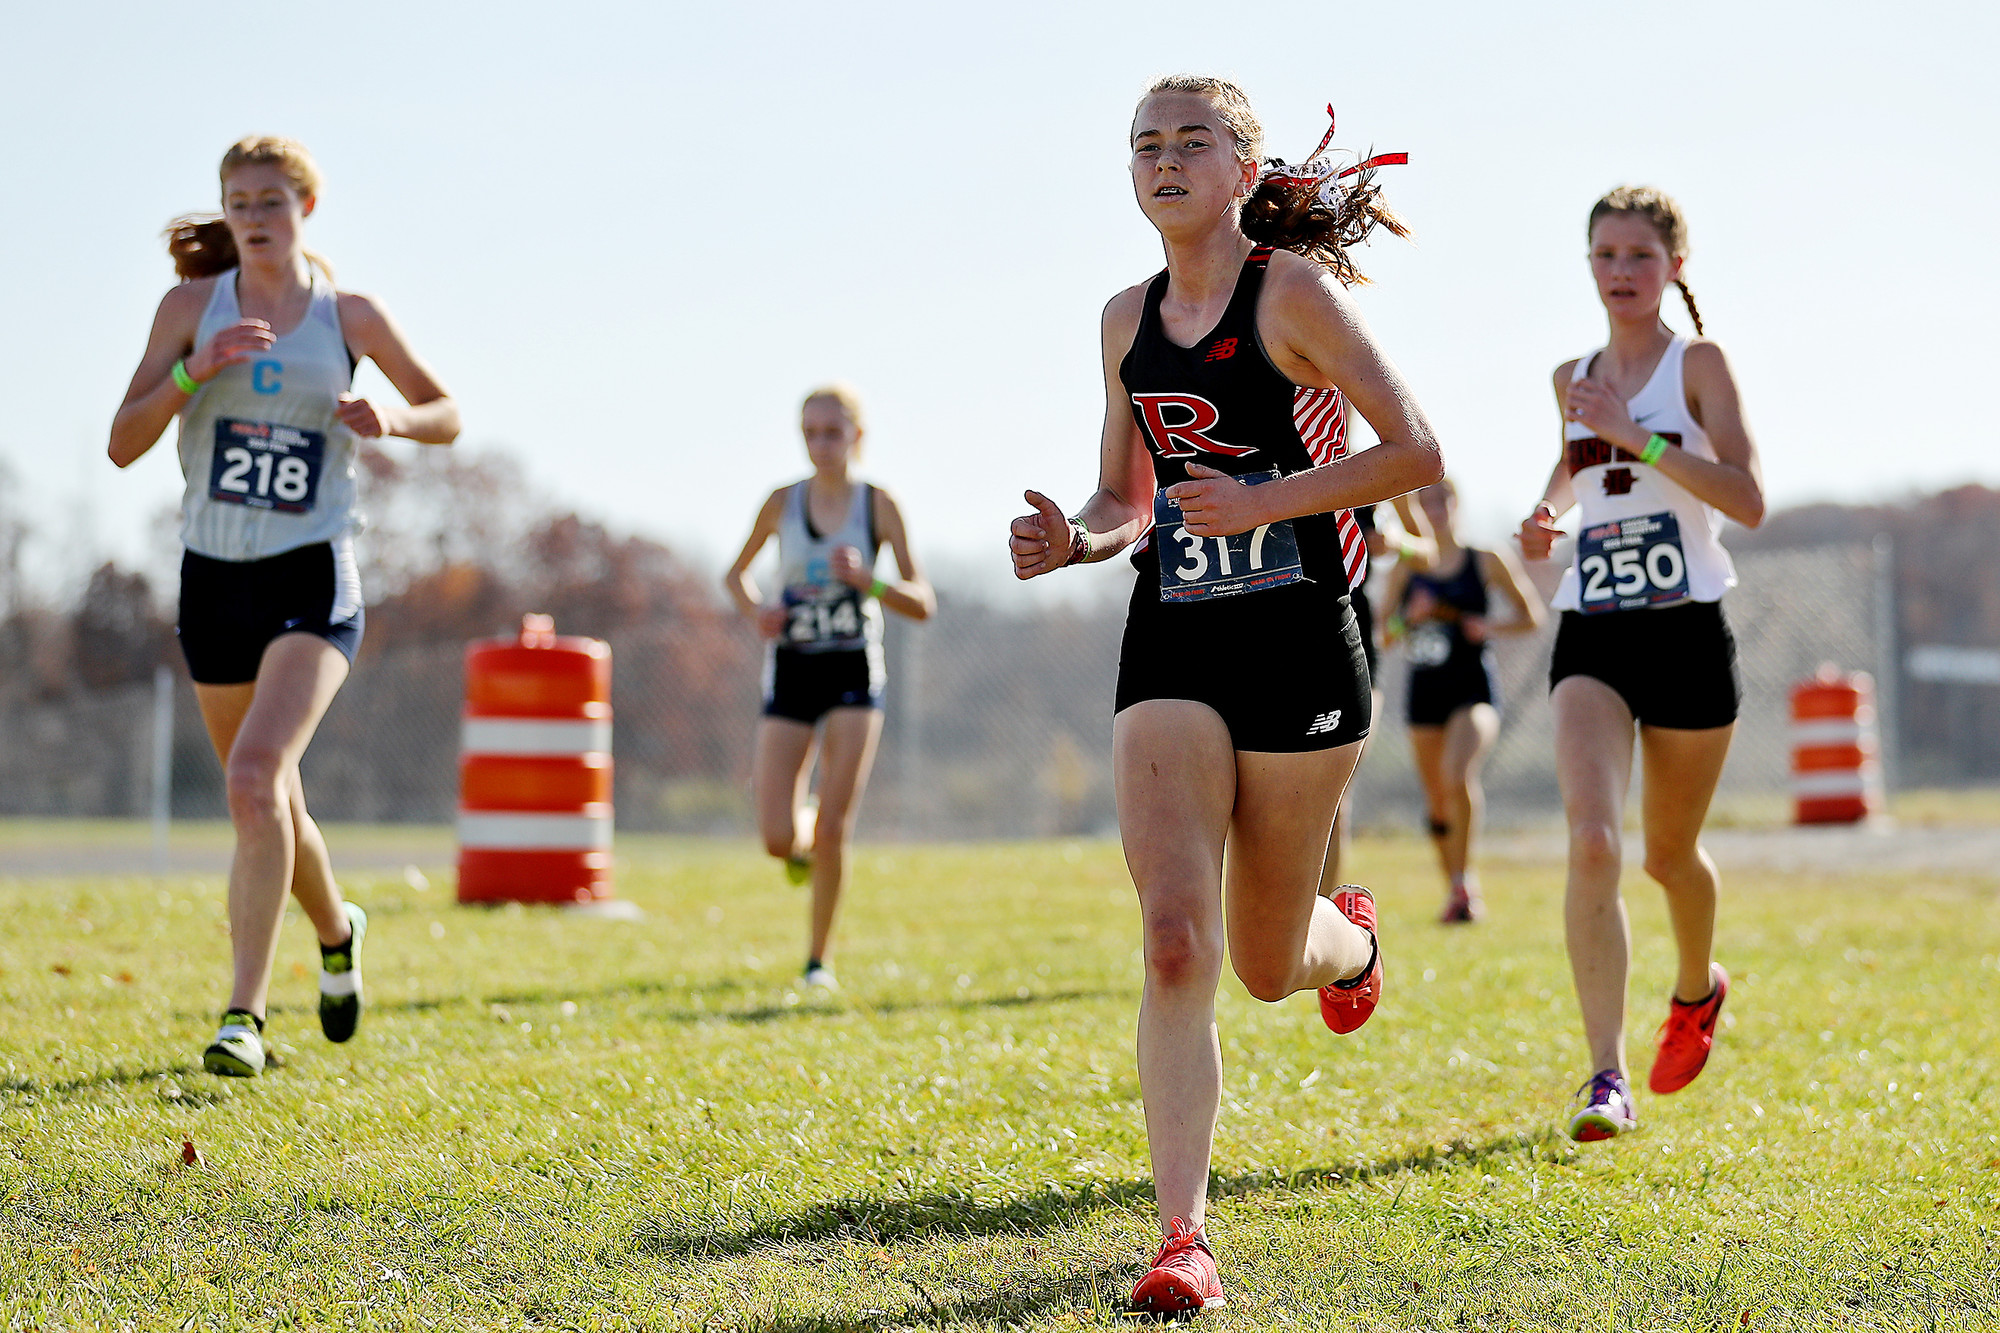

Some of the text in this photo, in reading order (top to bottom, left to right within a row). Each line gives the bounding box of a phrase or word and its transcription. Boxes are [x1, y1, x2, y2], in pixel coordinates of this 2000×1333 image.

[252, 359, 284, 395] C
[1132, 392, 1260, 458] R
[219, 446, 310, 503] 218
[1581, 542, 1685, 603] 250
[789, 600, 858, 642] 214
